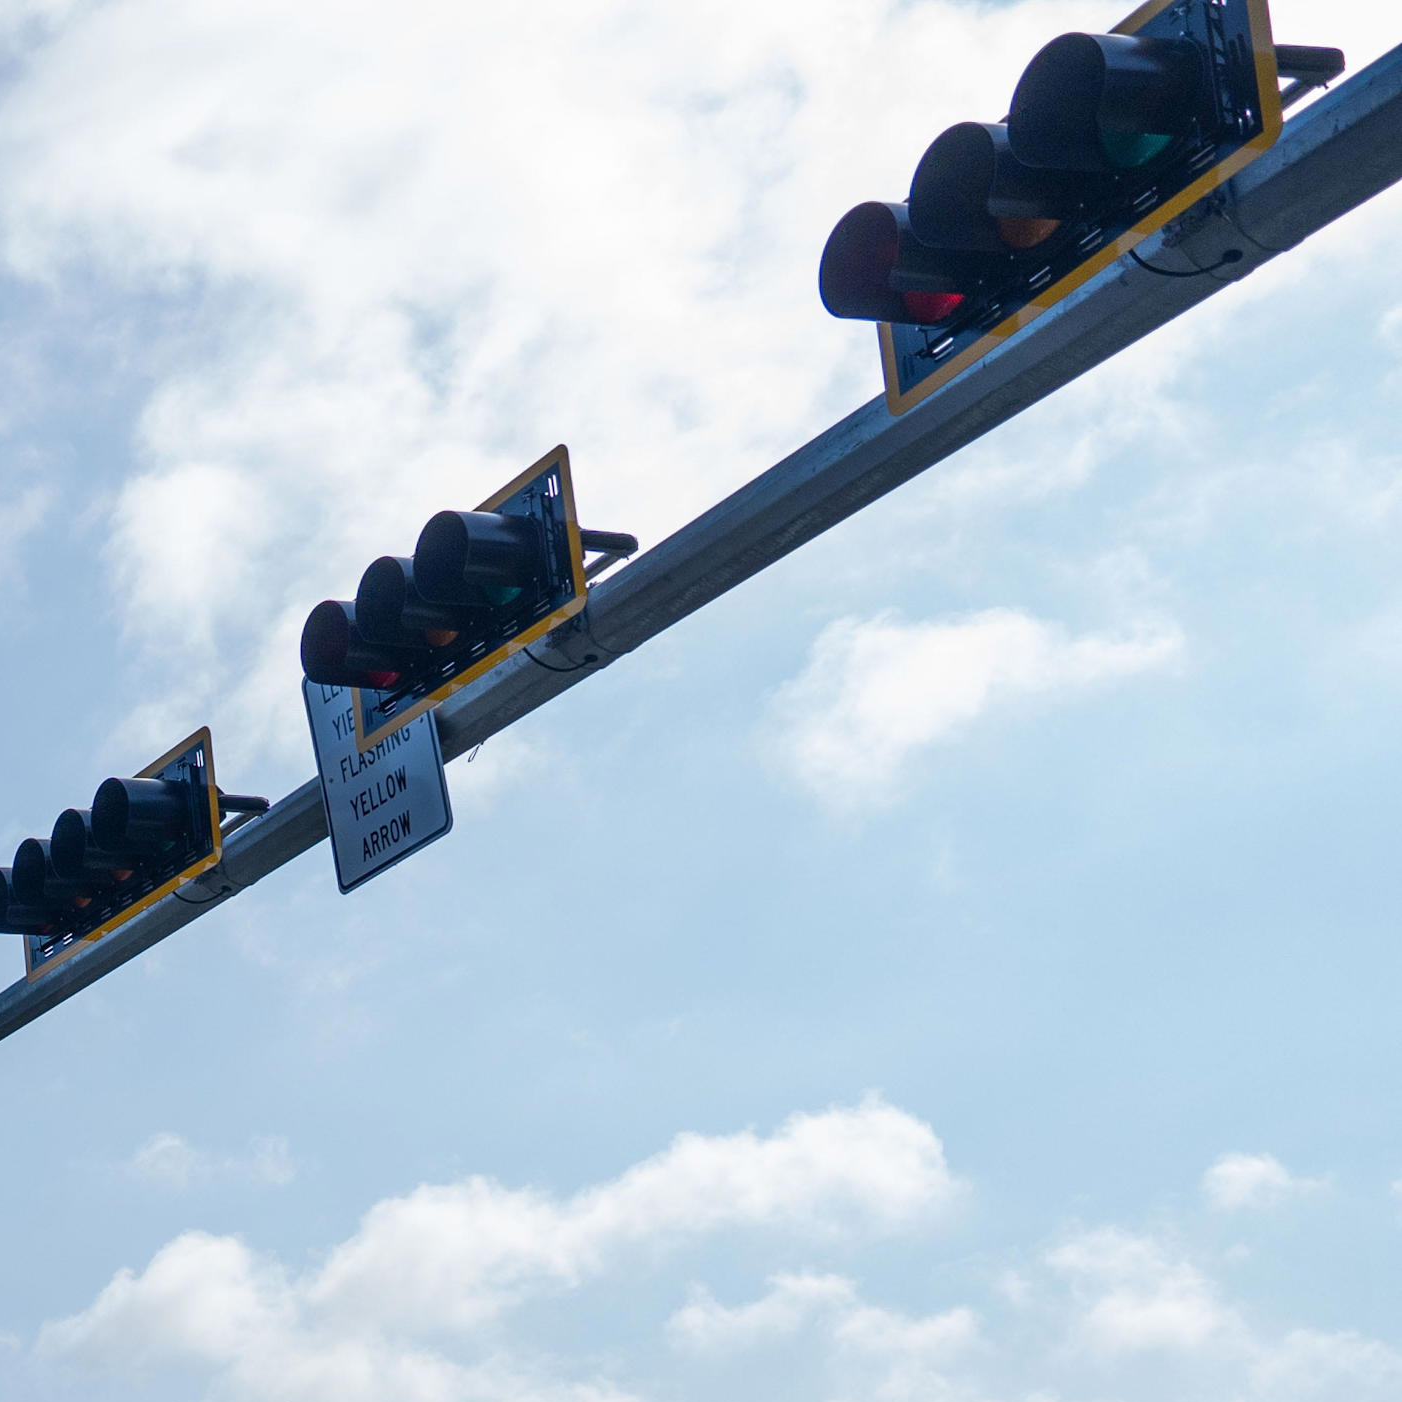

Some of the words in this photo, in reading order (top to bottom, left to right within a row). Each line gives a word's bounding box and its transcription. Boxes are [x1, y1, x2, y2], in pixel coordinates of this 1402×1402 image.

[340, 727, 411, 783] FLASHING
[350, 765, 407, 821] YELLOW
[363, 810, 411, 862] ARROW
